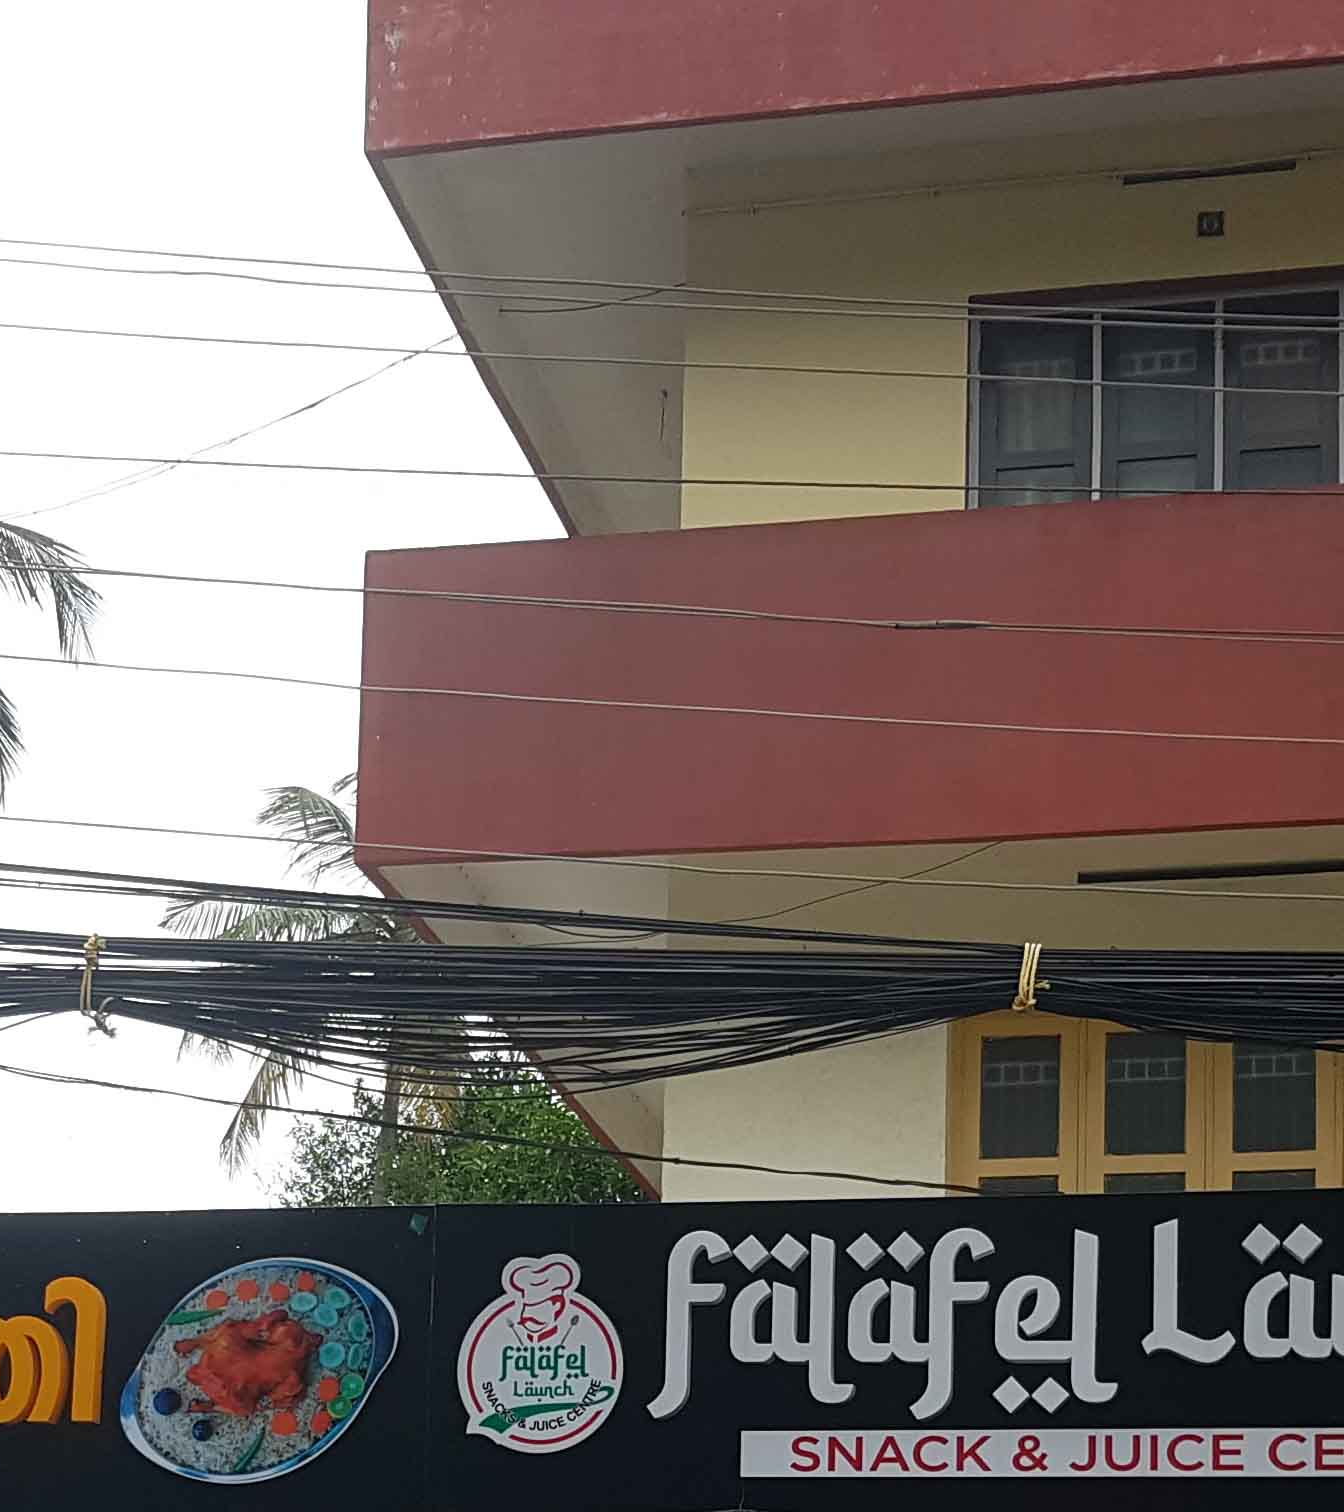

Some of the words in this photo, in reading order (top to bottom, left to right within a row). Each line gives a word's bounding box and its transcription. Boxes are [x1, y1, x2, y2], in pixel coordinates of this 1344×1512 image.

[518, 1419, 527, 1429] &
[529, 1415, 566, 1432] JUICE
[567, 1379, 602, 1422] CENTRE
[789, 1434, 993, 1473] SNACK
[1011, 1434, 1049, 1473] &
[1069, 1433, 1244, 1473] JUICE
